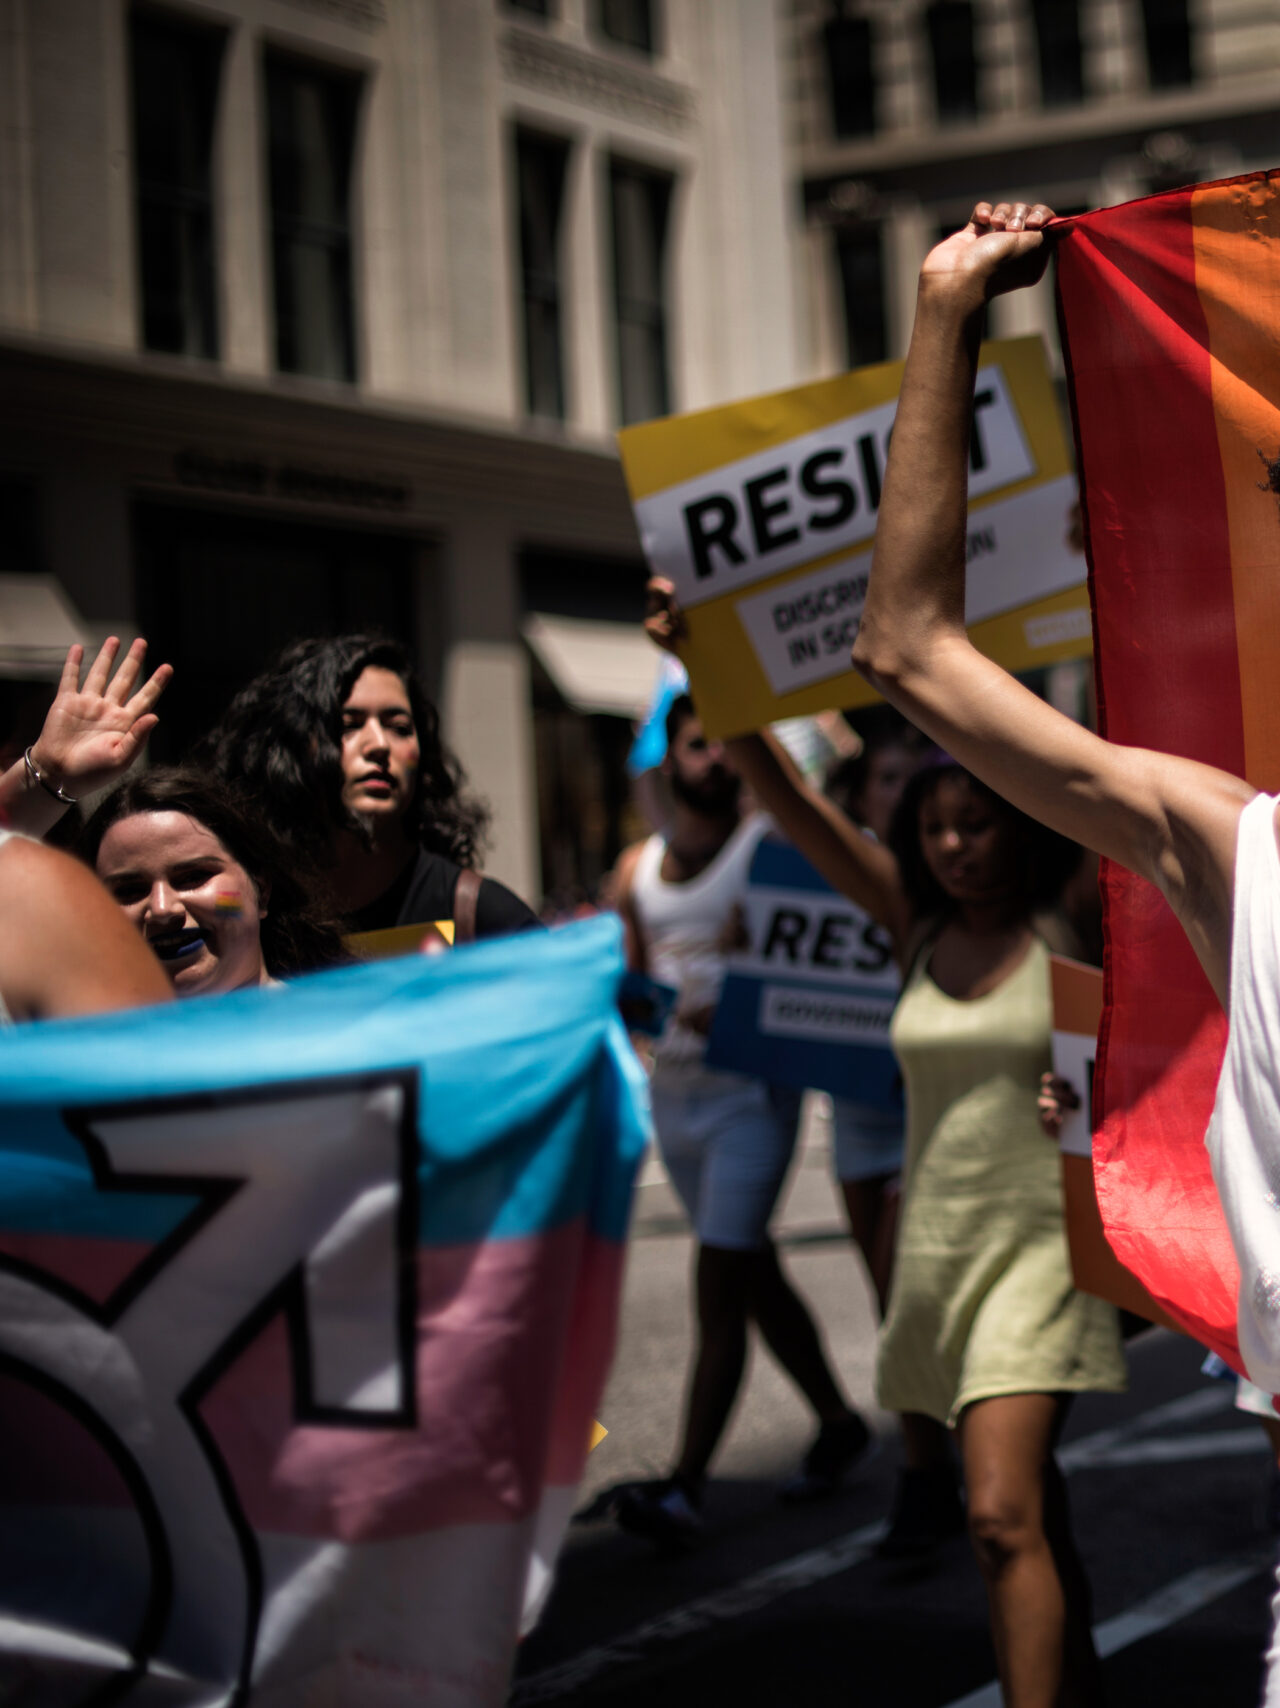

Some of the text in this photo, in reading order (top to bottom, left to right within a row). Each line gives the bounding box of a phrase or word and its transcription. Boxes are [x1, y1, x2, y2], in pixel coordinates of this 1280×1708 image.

[684, 390, 994, 577] RESIT
[787, 627, 820, 668] IN
[763, 909, 893, 970] RES
